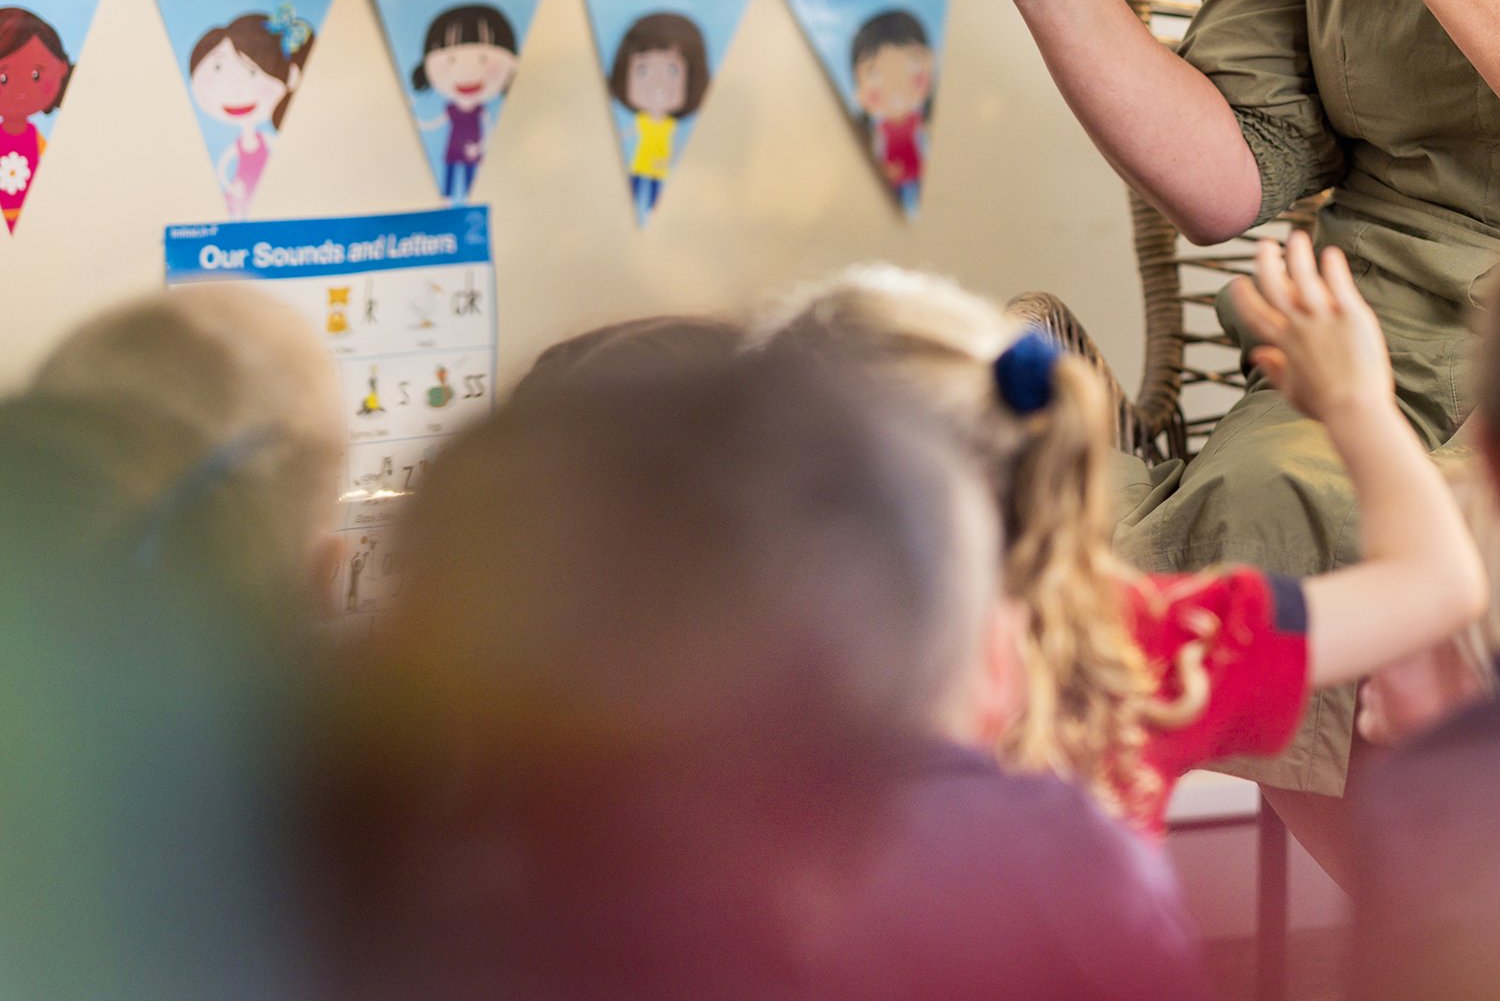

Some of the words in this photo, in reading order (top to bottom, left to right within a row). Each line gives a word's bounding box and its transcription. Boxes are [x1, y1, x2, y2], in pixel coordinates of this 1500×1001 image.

[200, 245, 247, 269] Our
[253, 239, 345, 268] Sounds
[349, 236, 388, 262] and
[389, 230, 457, 257] Letters
